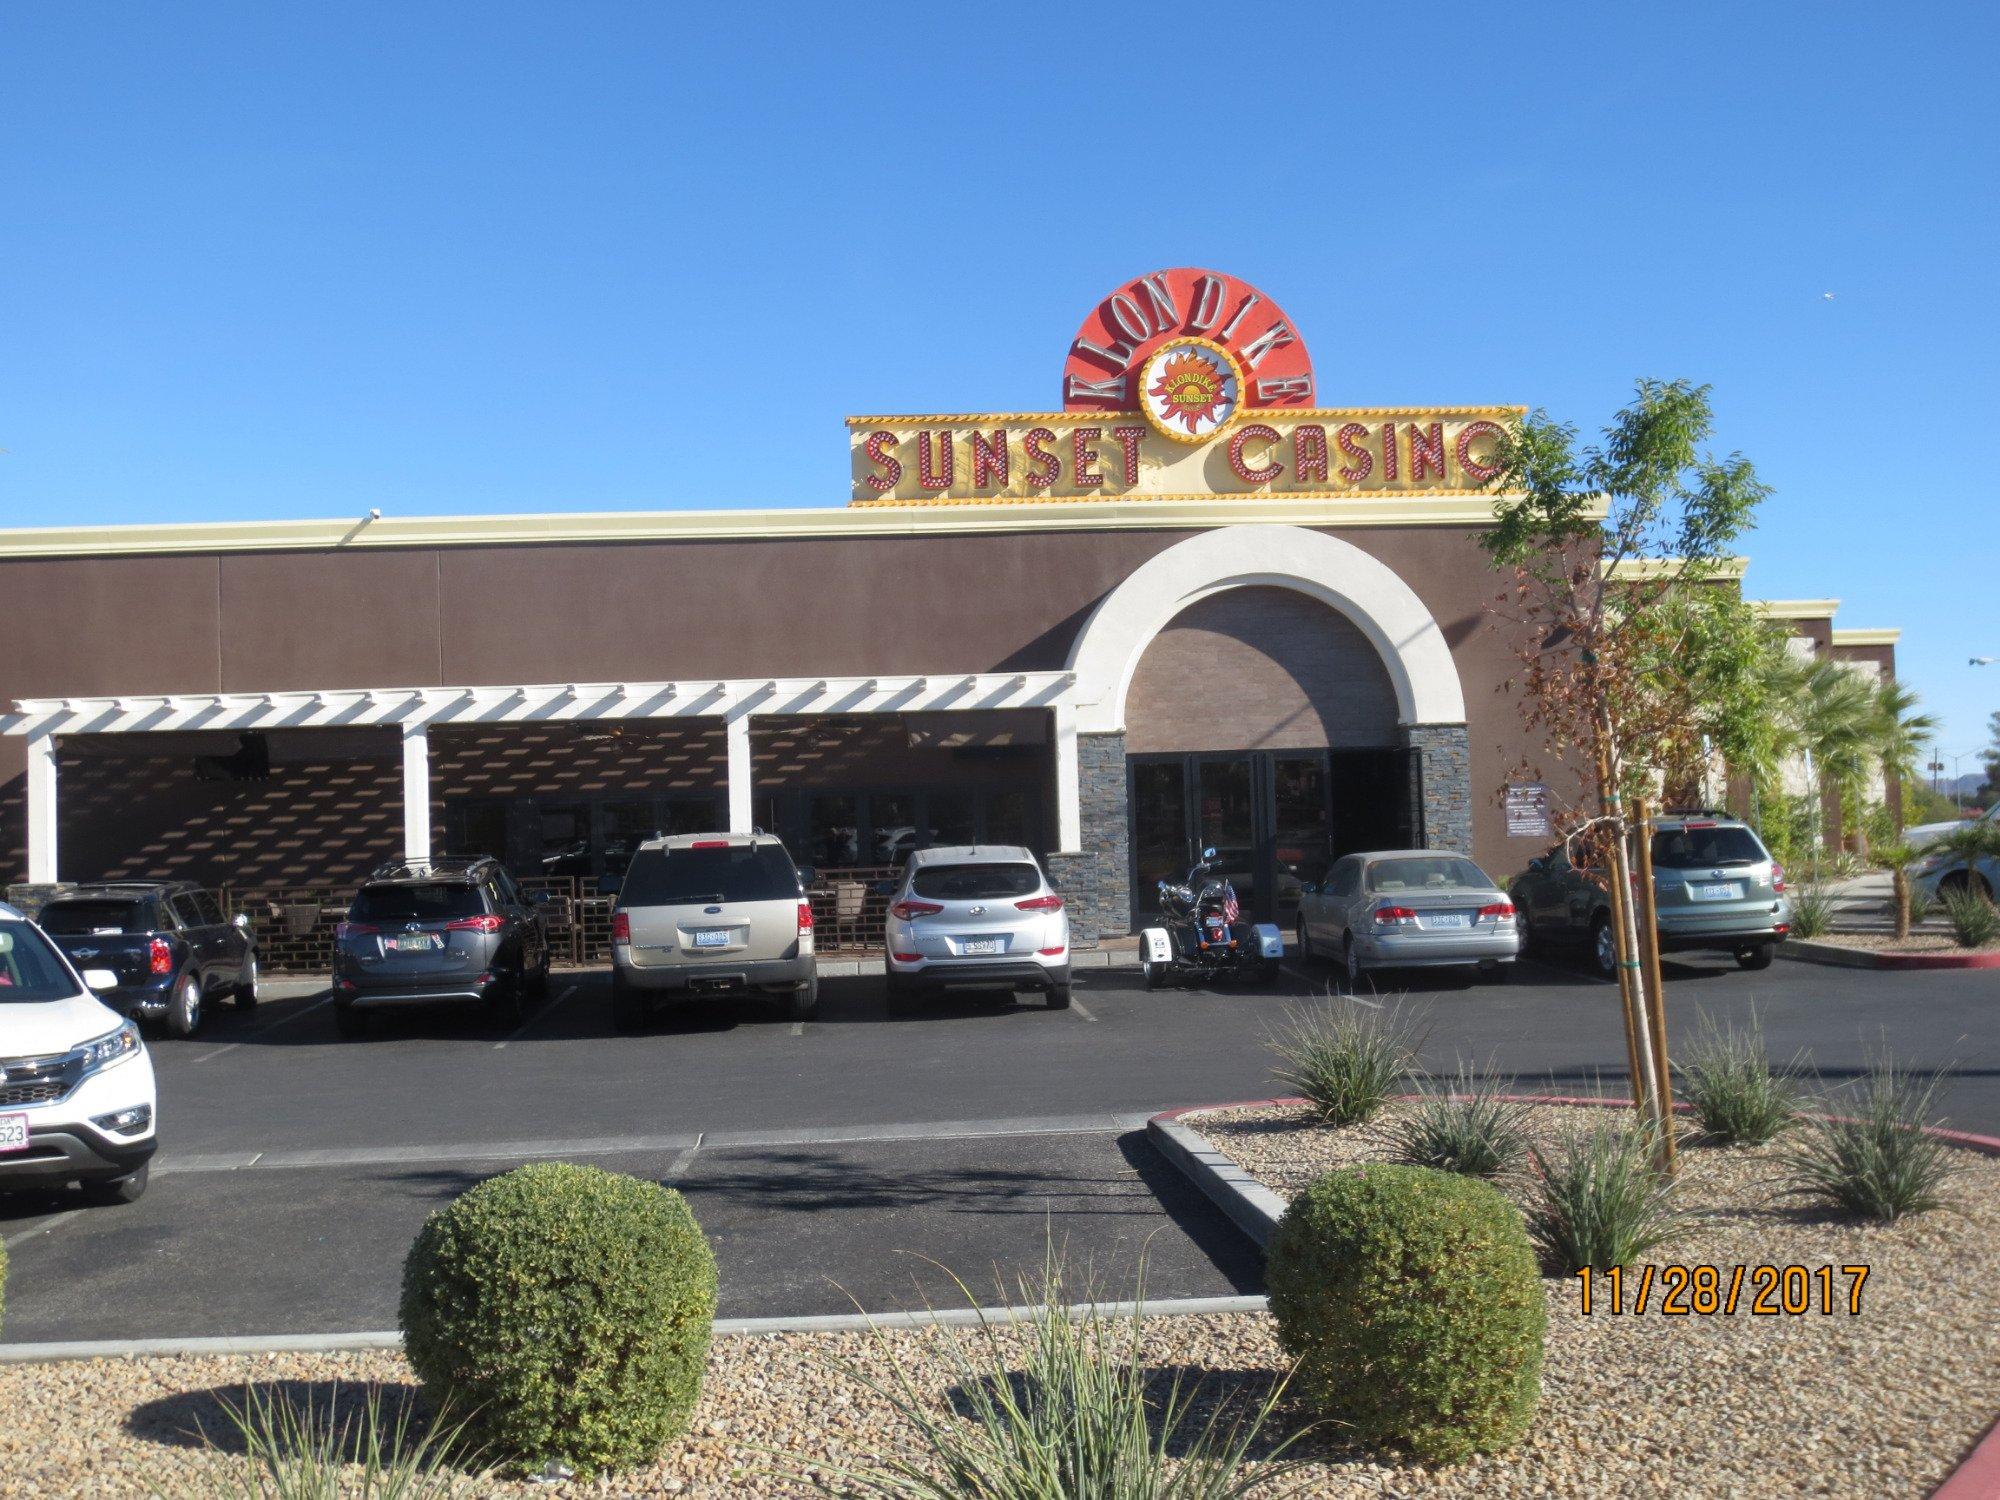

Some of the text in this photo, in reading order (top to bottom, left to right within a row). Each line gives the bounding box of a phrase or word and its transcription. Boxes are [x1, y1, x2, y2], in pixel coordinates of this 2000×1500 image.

[1070, 270, 1312, 402] KLONDIKE
[1165, 373, 1217, 393] KLONDIKE
[1173, 394, 1213, 403] SUNSET
[866, 421, 1511, 490] SUNSET CASINO
